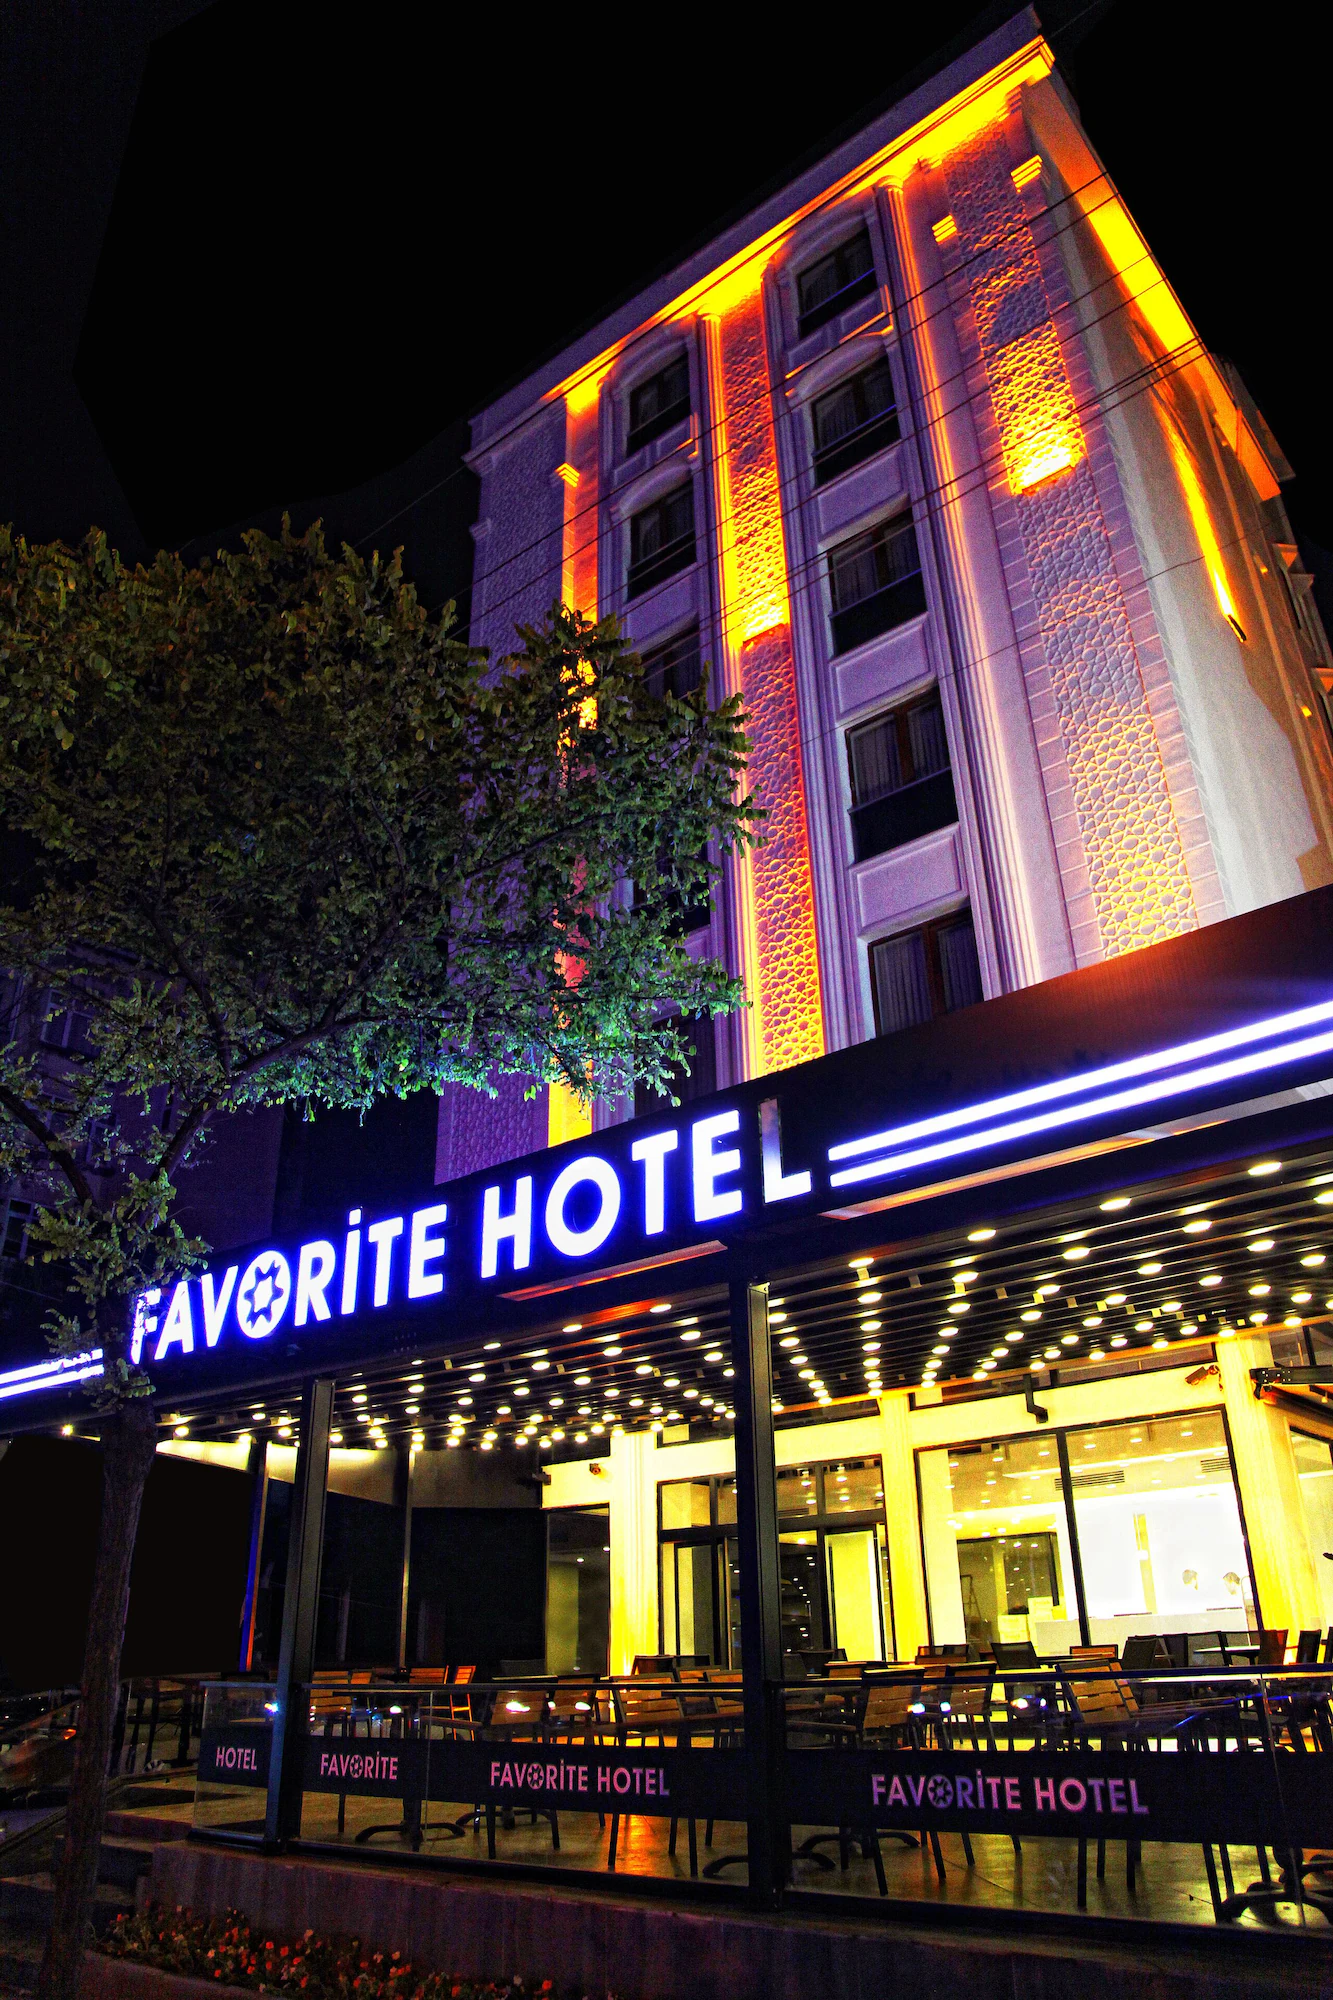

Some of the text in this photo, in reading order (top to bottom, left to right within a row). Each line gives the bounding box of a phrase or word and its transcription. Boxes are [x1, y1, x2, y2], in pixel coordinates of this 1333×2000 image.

[481, 1098, 812, 1278] HOTEL
[215, 1746, 257, 1771] HOTEL
[597, 1766, 670, 1796] HOTEL
[1033, 1777, 1149, 1814] HOTEL
